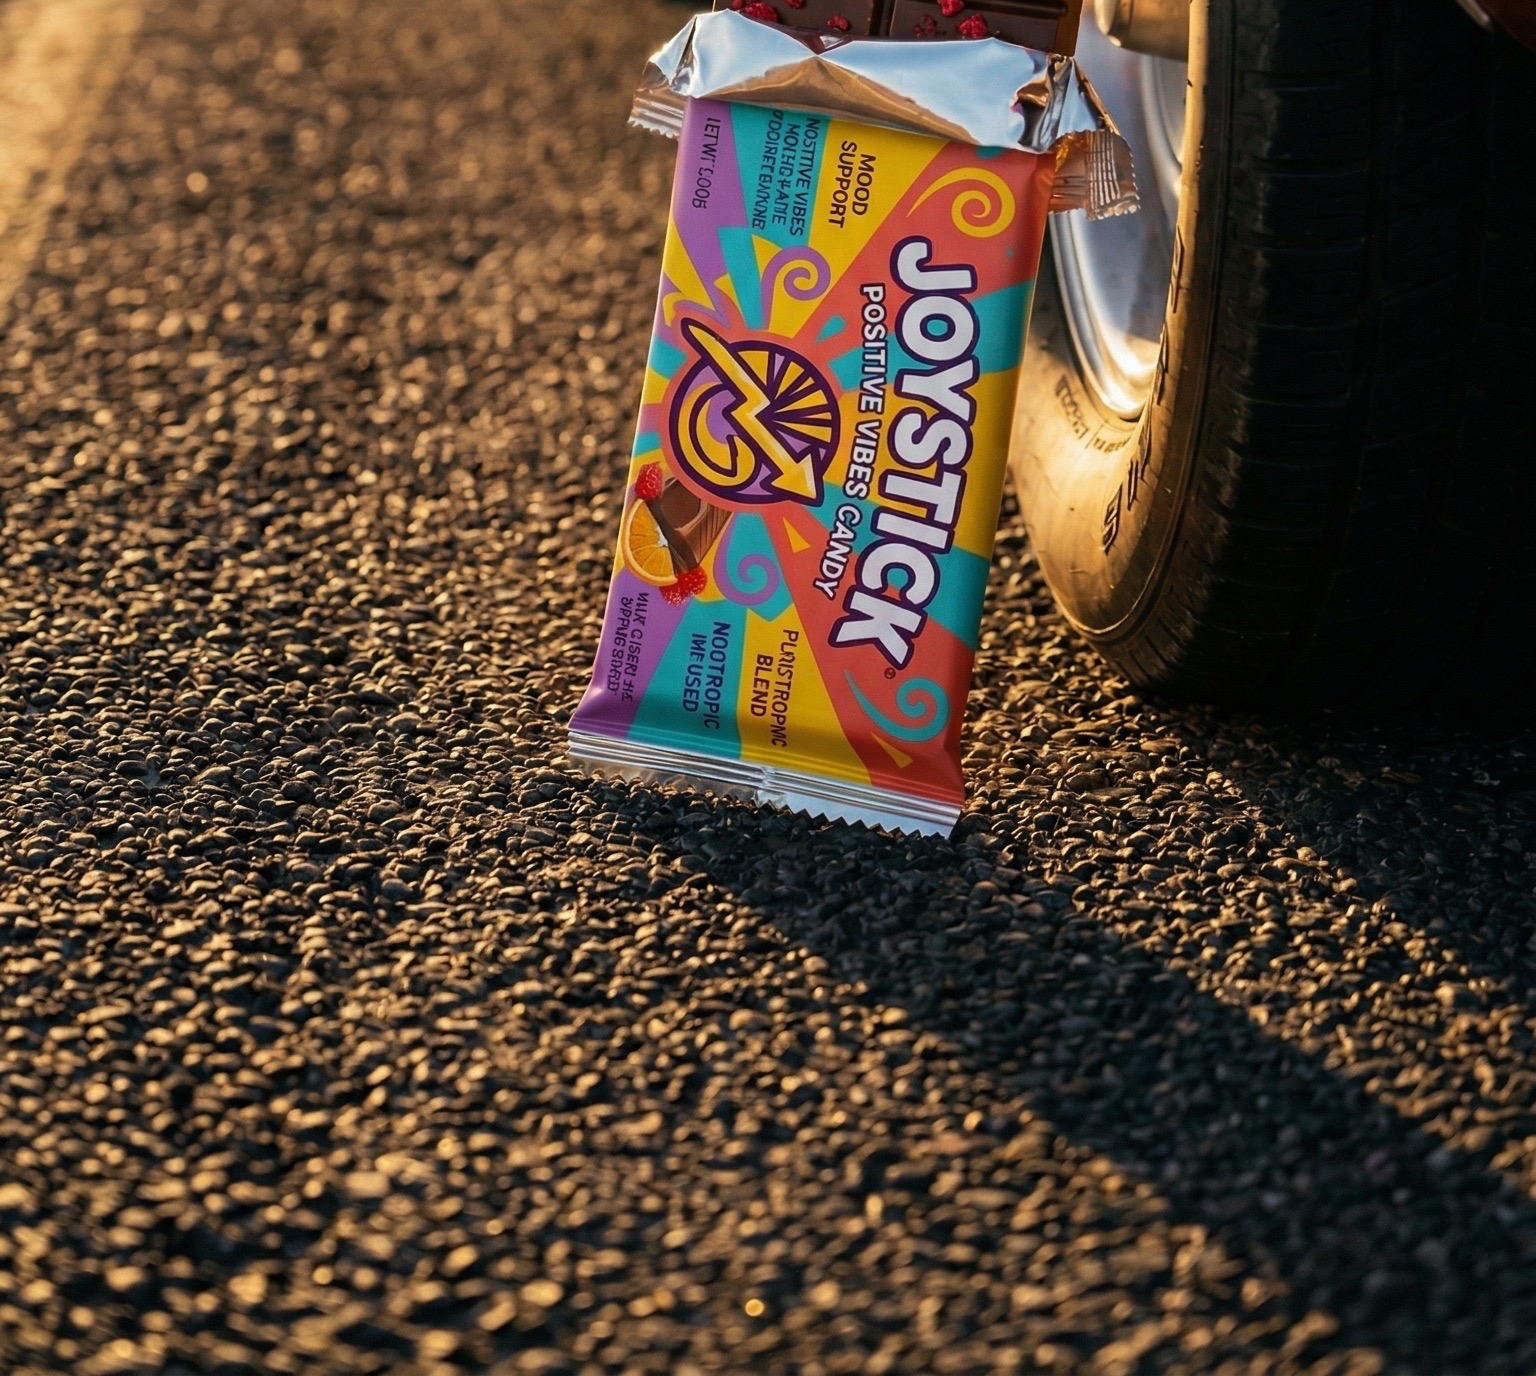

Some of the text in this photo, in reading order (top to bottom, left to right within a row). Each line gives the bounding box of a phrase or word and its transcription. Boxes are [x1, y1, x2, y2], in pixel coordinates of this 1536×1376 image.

[789, 191, 809, 236] VIBES
[828, 140, 857, 228] SUPPORT
[852, 153, 876, 216] MOOD
[814, 283, 886, 600] POSITIVE VIBES CANDY
[830, 235, 979, 670] JOYSTICK
[704, 621, 731, 730] NOOTROPIC
[750, 654, 774, 717] BLEND
